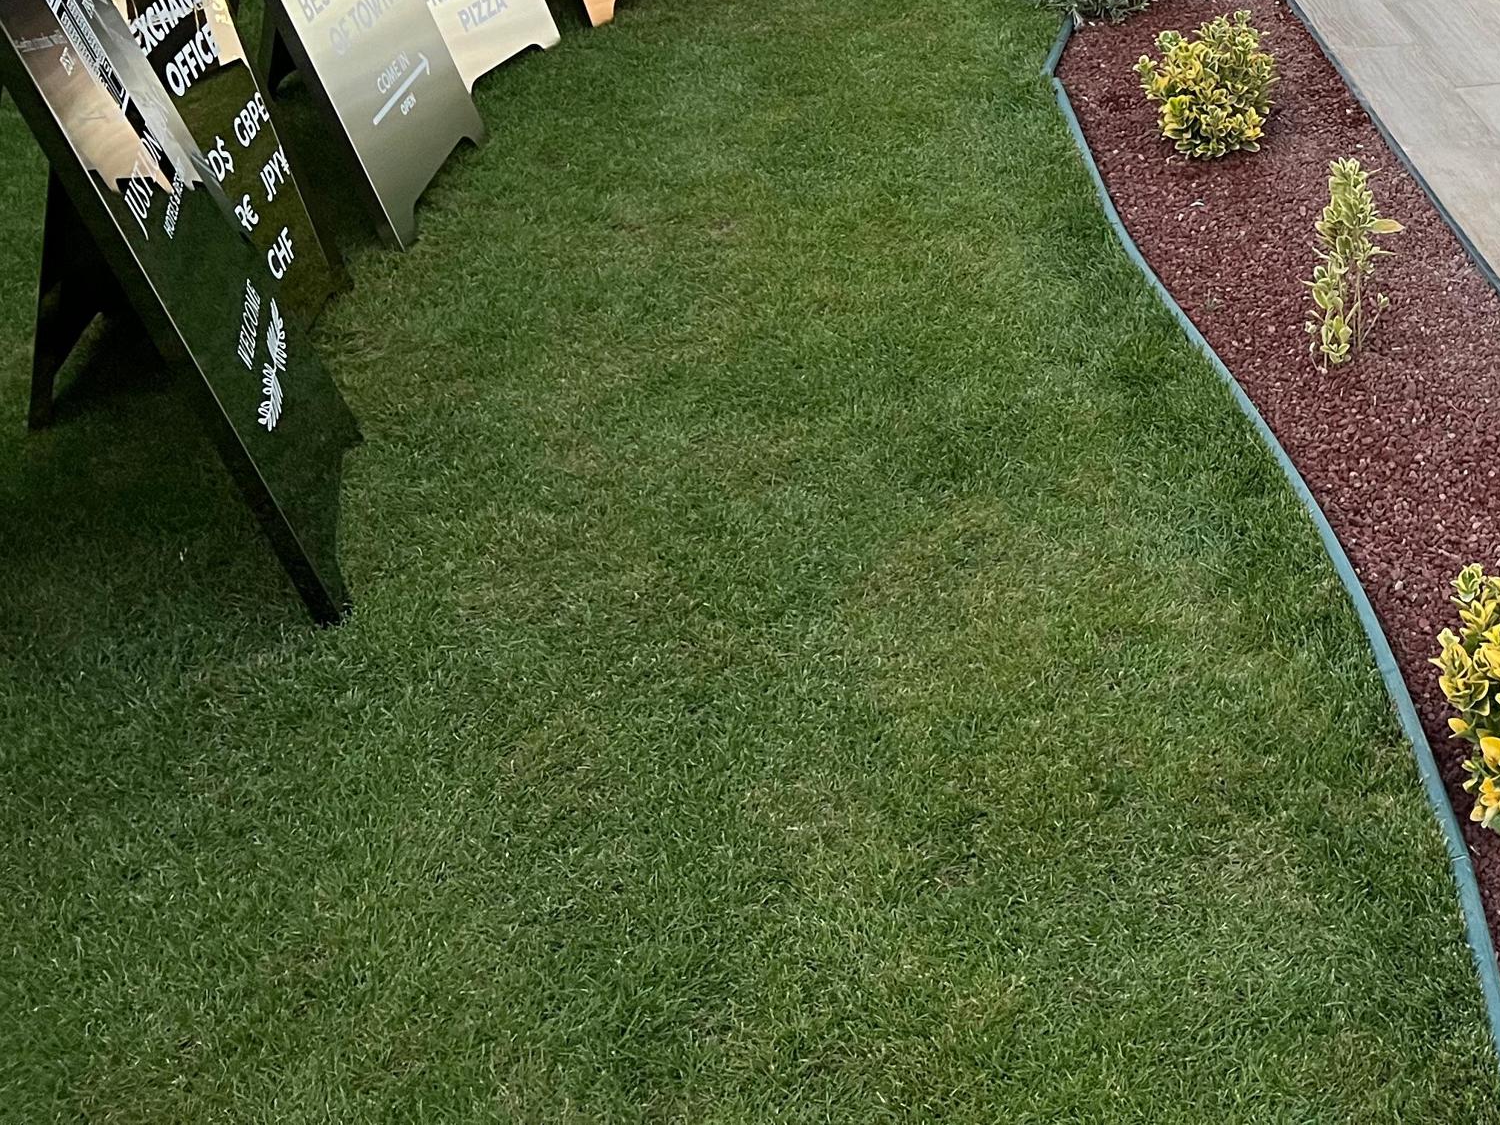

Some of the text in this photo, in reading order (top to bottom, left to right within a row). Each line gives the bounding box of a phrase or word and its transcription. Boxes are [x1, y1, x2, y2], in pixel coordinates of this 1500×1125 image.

[165, 23, 220, 97] OFFICE
[329, 16, 351, 57] OF
[377, 59, 403, 95] COME
[400, 91, 418, 116] OPEN
[267, 226, 295, 280] CHF
[237, 278, 261, 371] WELCOME
